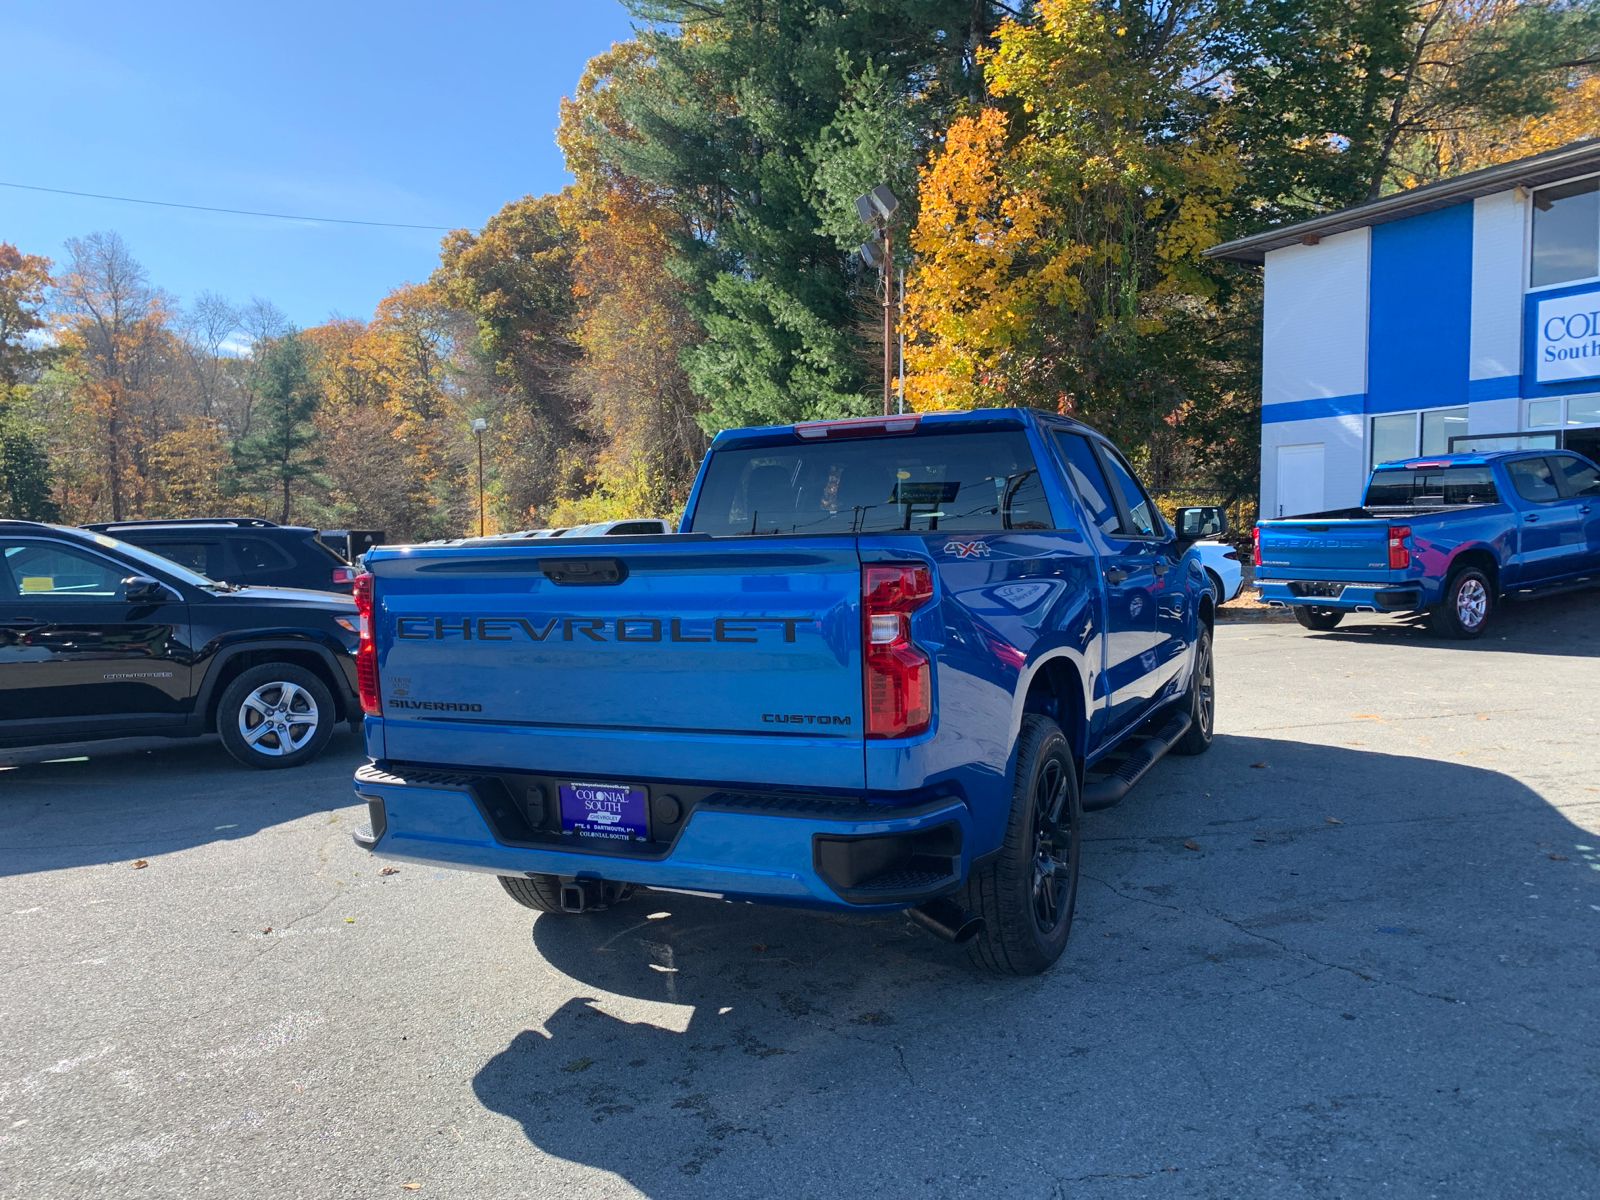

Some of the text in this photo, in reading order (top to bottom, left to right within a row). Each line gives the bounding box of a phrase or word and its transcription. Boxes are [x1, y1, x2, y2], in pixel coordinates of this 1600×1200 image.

[1544, 340, 1600, 363] South
[396, 616, 814, 643] CHEVROLET
[388, 699, 482, 713] SILVERADO
[761, 713, 851, 726] CUSTOM
[576, 790, 629, 803] COLONIAL
[584, 800, 621, 812] SOUTH
[590, 814, 618, 822] CHEVROLET
